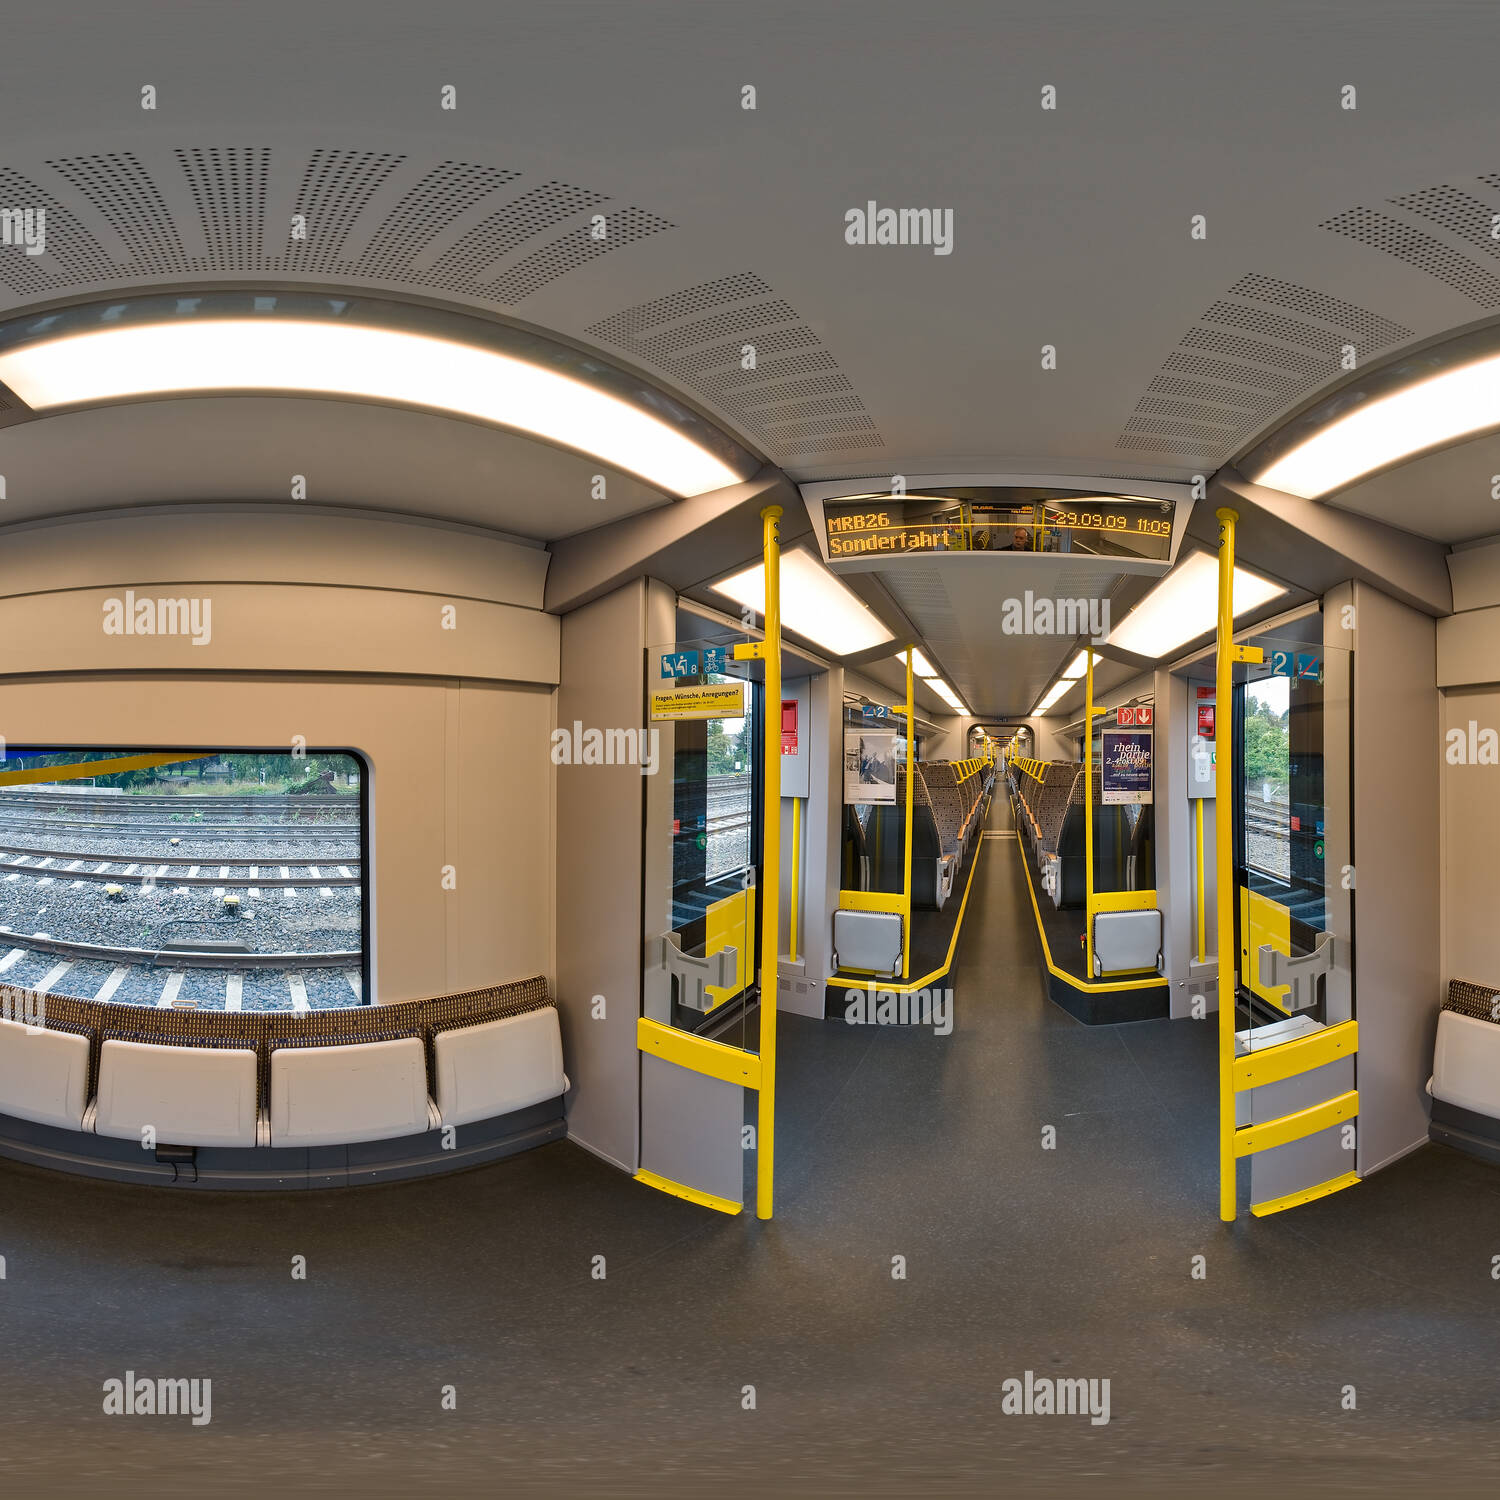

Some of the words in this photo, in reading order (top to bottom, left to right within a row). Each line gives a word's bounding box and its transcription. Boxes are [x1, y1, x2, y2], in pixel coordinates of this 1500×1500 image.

[828, 513, 890, 532] MRB26
[1056, 507, 1127, 529] 29.09.09
[1138, 514, 1171, 534] 11:09
[830, 530, 950, 554] Sonderfahrt
[691, 664, 697, 674] 8
[1273, 652, 1287, 676] 2
[675, 692, 700, 700] Wünsche,
[702, 690, 738, 698] Anregungen?
[877, 706, 885, 718] 2
[1114, 742, 1140, 752] rhein
